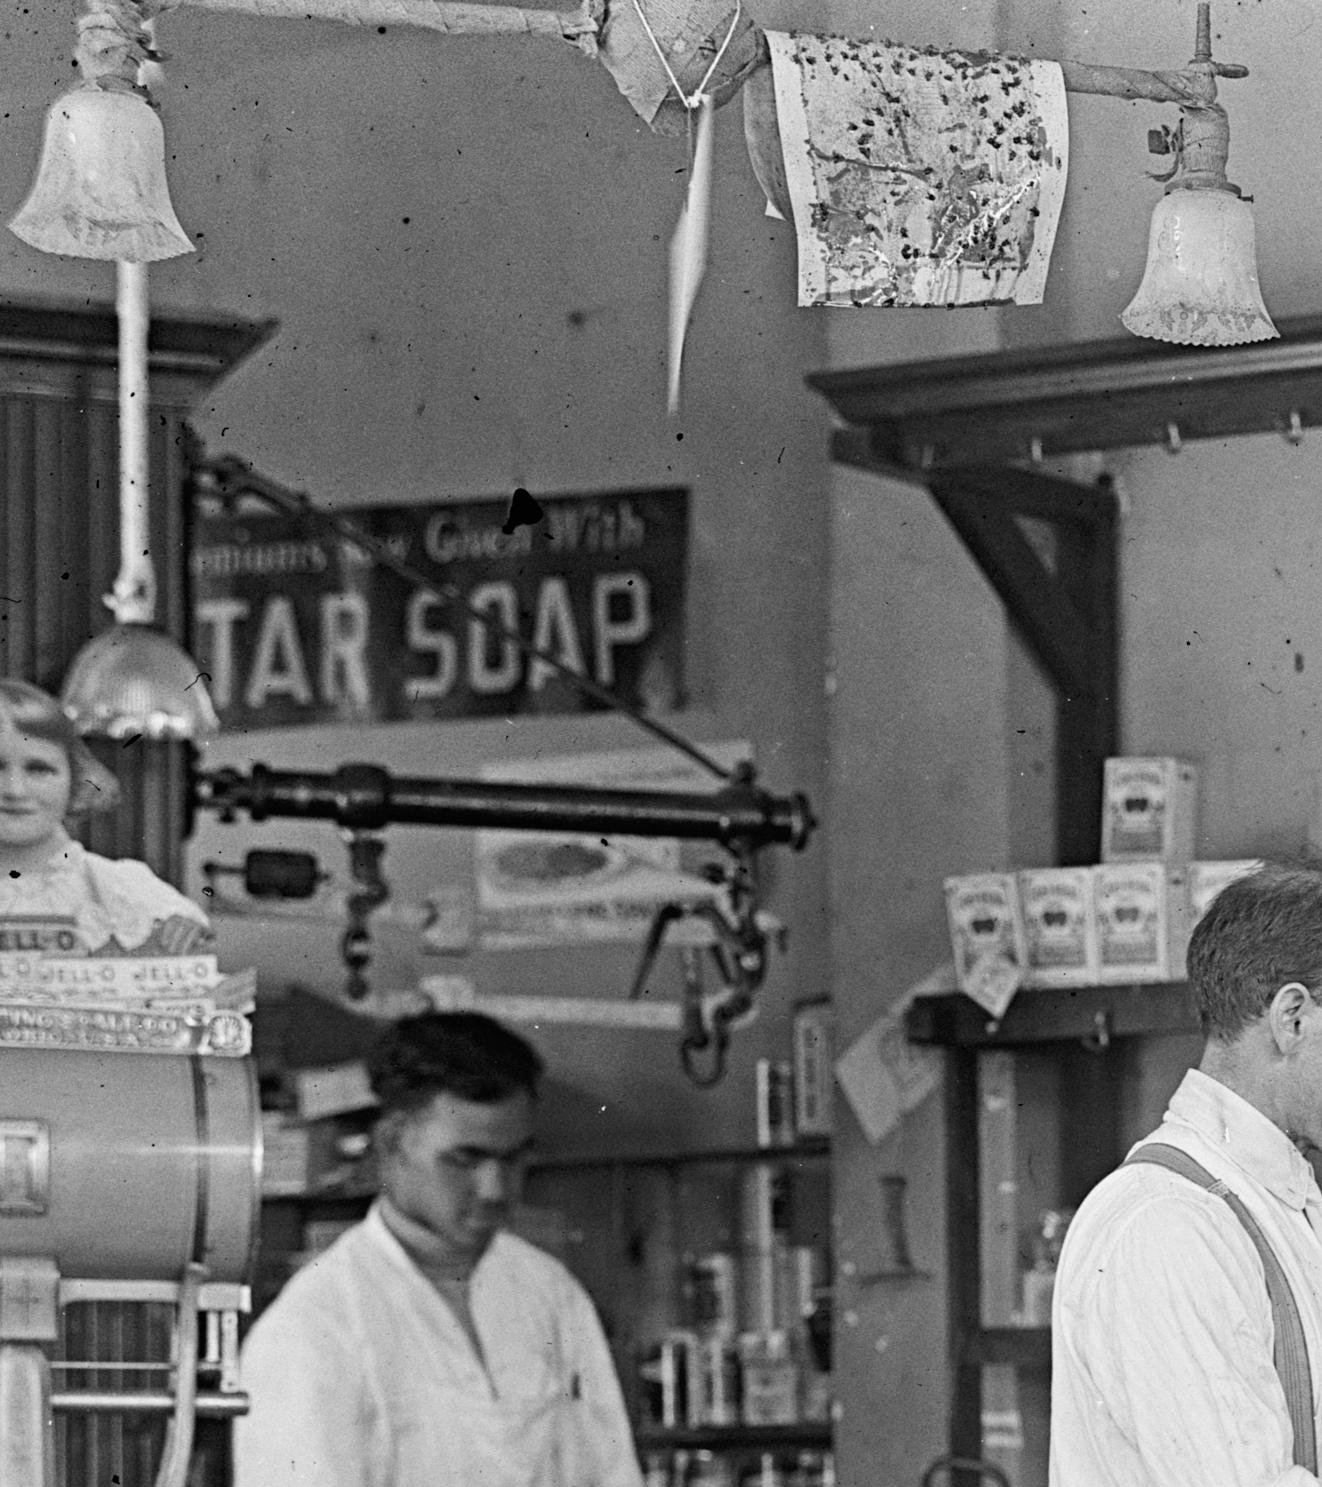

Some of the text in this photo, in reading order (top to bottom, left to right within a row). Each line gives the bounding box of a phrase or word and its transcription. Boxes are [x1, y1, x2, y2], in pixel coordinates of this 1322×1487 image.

[194, 570, 652, 709] TAR SOAP
[0, 930, 75, 951] ELL-O
